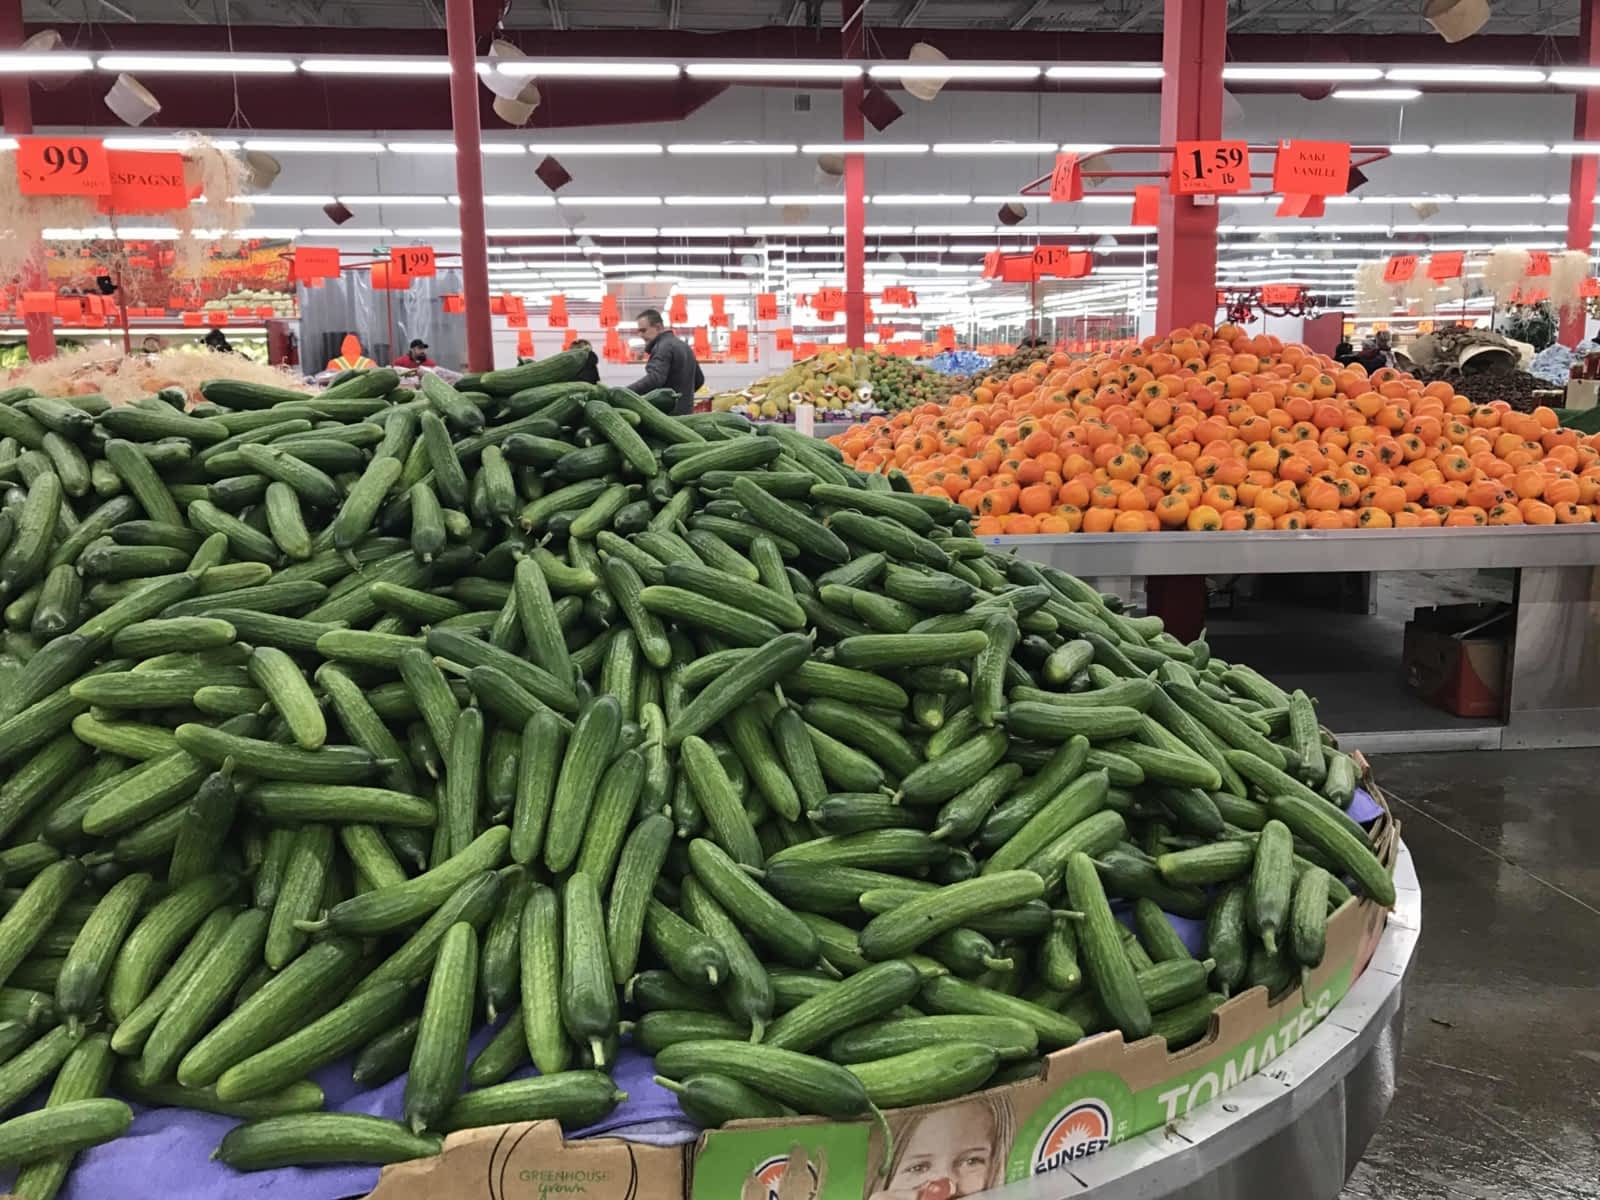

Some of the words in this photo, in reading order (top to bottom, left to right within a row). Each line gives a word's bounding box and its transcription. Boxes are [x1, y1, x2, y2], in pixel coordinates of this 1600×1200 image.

[1298, 151, 1326, 162] KAKI
[1293, 166, 1337, 177] VANILLE
[111, 172, 181, 187] ESPAGNE
[1222, 172, 1235, 185] lb
[1035, 1139, 1109, 1175] SUNSET
[519, 1169, 610, 1183] GREENHOUSE
